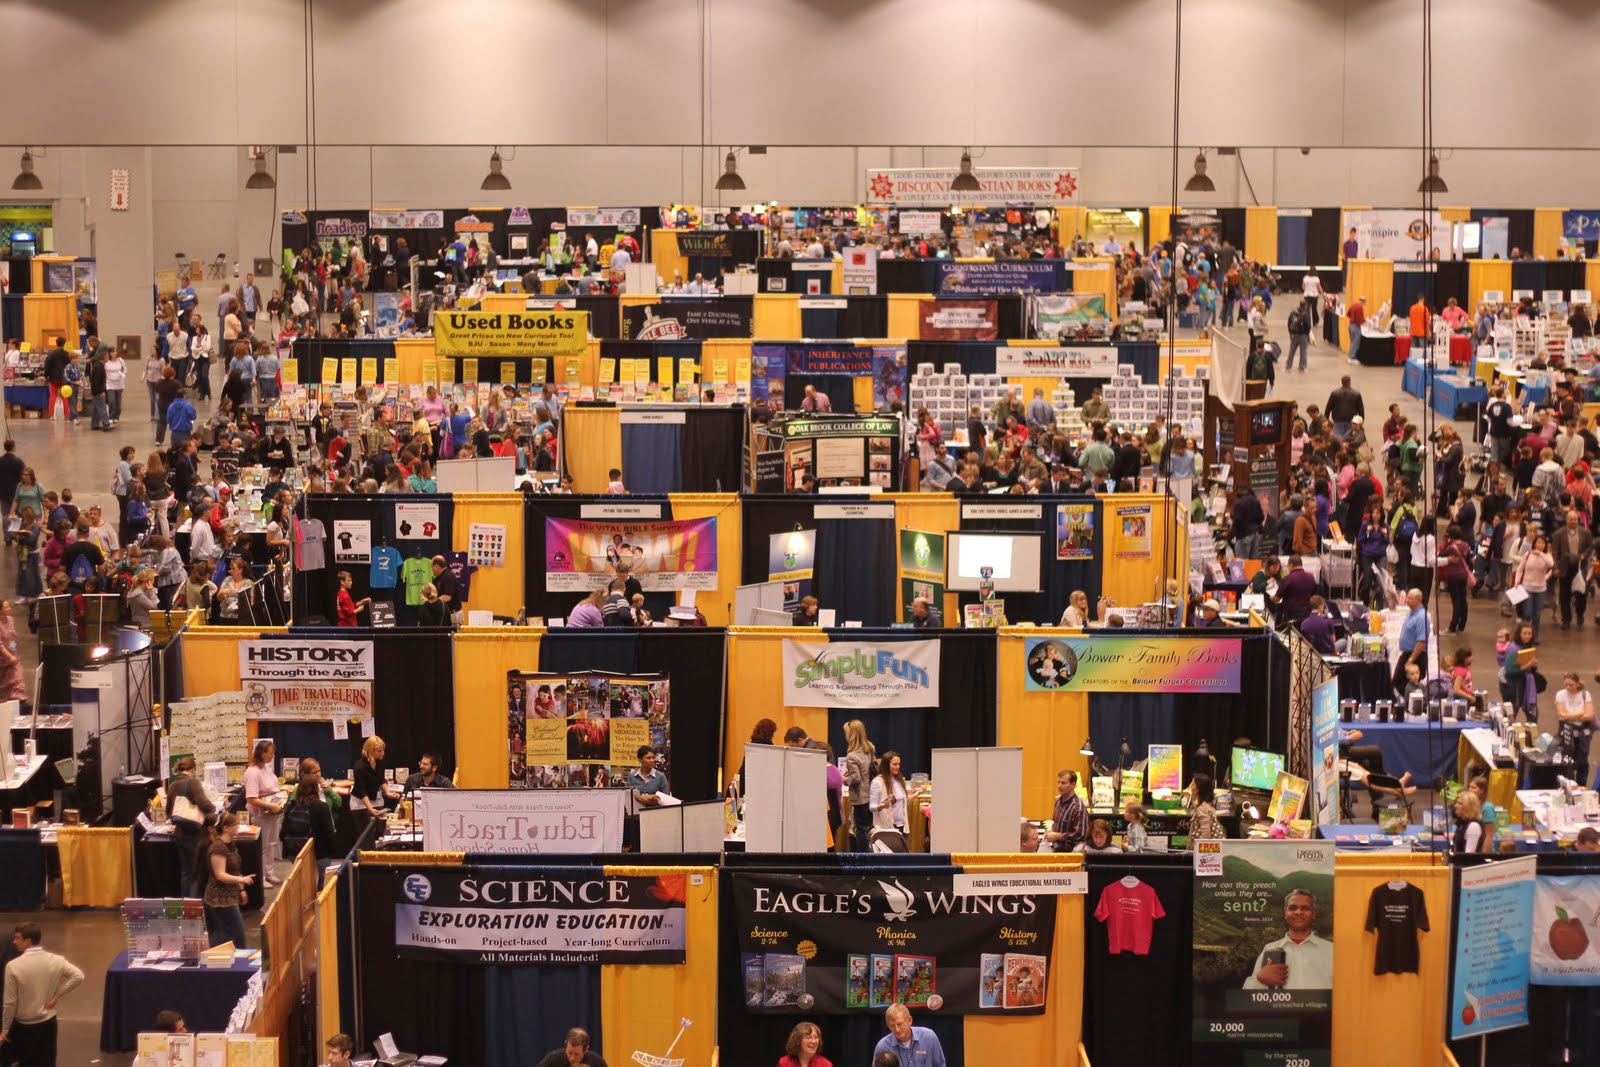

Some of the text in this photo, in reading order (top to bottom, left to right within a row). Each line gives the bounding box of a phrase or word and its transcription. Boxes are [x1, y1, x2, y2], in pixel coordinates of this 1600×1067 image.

[898, 181, 951, 192] DISCOUNT
[1017, 180, 1051, 191] BOOKS
[316, 218, 367, 237] Reading
[450, 314, 574, 330] Used Books
[660, 324, 679, 336] BEE
[808, 351, 871, 359] INHERITANCE
[808, 362, 872, 370] PUBLICATIONS
[795, 425, 809, 433] OAK
[810, 424, 833, 432] BROOK
[833, 423, 865, 431] COLLEGE
[876, 422, 893, 430] LAW
[624, 525, 649, 533] BIBLE
[982, 569, 992, 577] 75
[249, 647, 366, 662] HISTORY
[1128, 646, 1181, 666] Family
[1187, 647, 1238, 665] Books
[249, 668, 366, 678] Through the Ages
[271, 688, 367, 708] TIME TRAVELERS
[1009, 879, 1042, 887] EDUCATIONAL
[1043, 878, 1072, 886] MATERIALS
[1253, 881, 1276, 889] preach
[459, 879, 630, 903] SCIENCE
[1239, 890, 1253, 898] they
[754, 888, 1036, 915] EAGLE'S WINGS
[1223, 898, 1267, 912] sent?
[419, 911, 549, 930] EXPLORATION
[556, 914, 665, 930] EDUCATION
[751, 926, 1038, 942] Science Phonics History
[412, 933, 671, 948] Hands-on Project-based Year-long Curriculum
[480, 953, 599, 962] All Materials Included!
[1251, 993, 1291, 1003] 100,000
[1305, 1001, 1328, 1009] villages
[1210, 1023, 1244, 1033] 20,000
[1286, 1059, 1310, 1067] 2020
